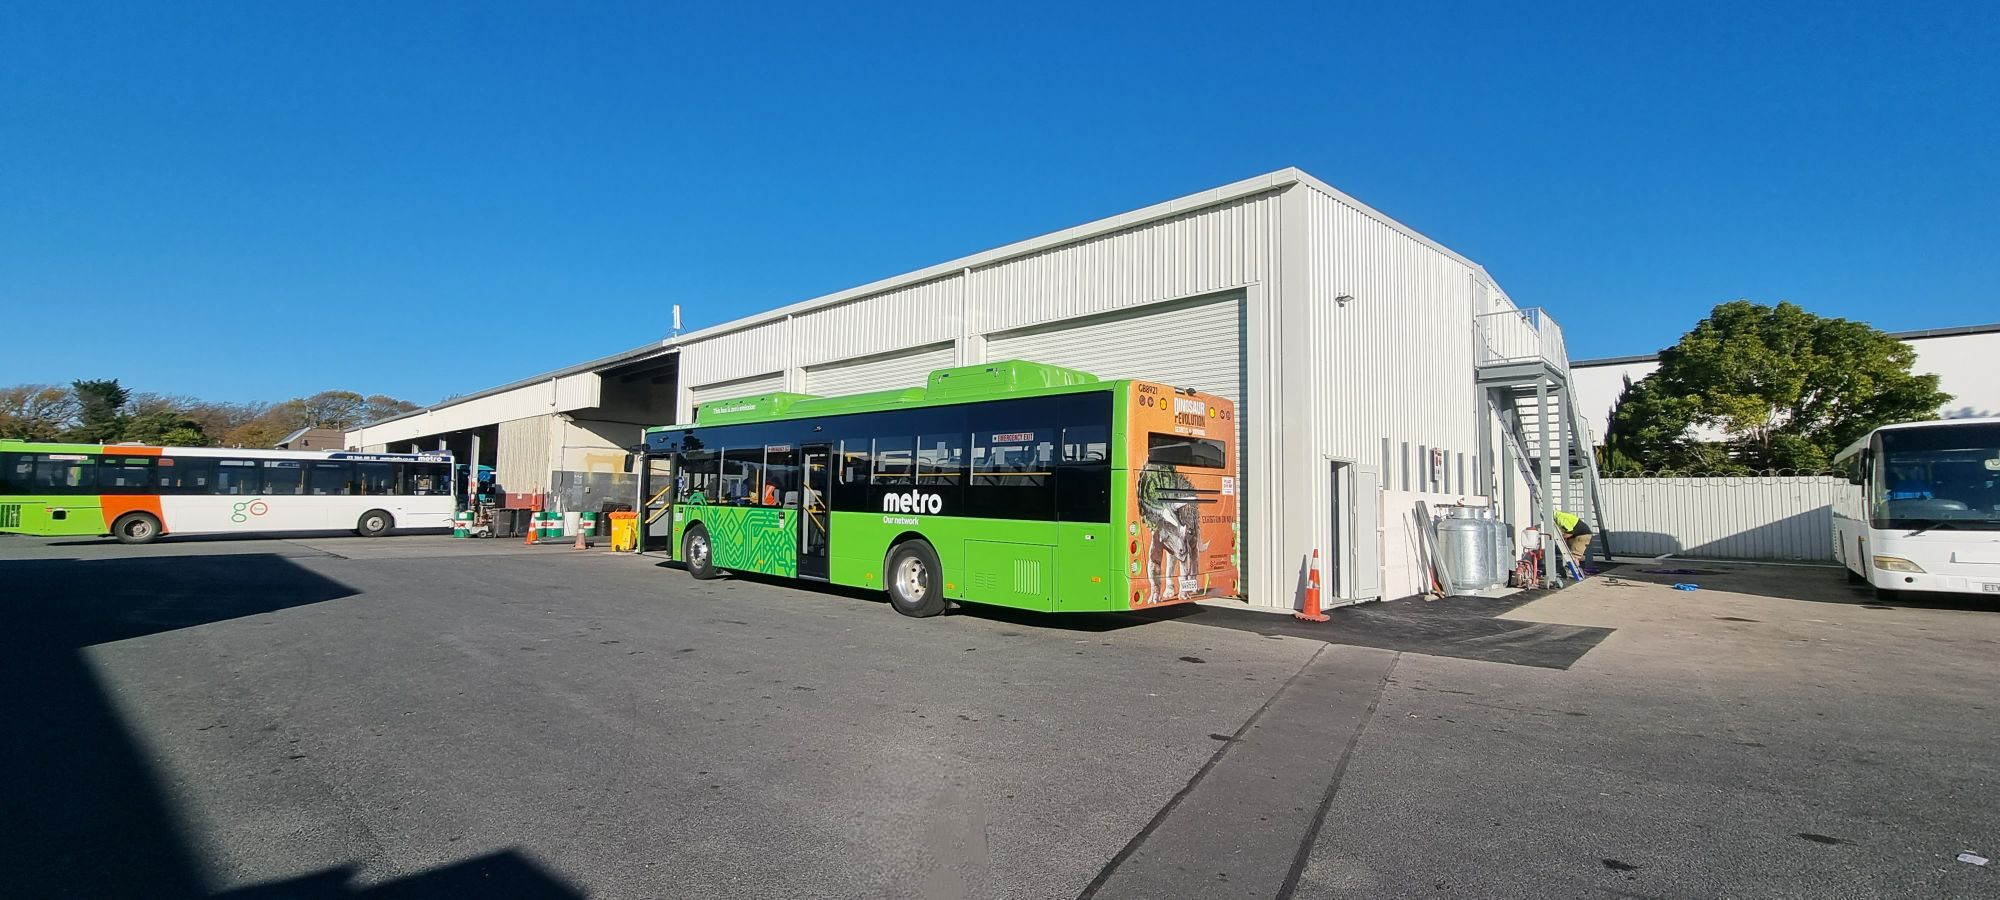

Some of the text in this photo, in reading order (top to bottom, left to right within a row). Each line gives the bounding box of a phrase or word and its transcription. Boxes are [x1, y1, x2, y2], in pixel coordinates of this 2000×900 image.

[1174, 398, 1205, 415] DINOSAUR
[1023, 432, 1033, 441] EXIT
[883, 489, 942, 514] metro
[883, 515, 919, 526] Our network
